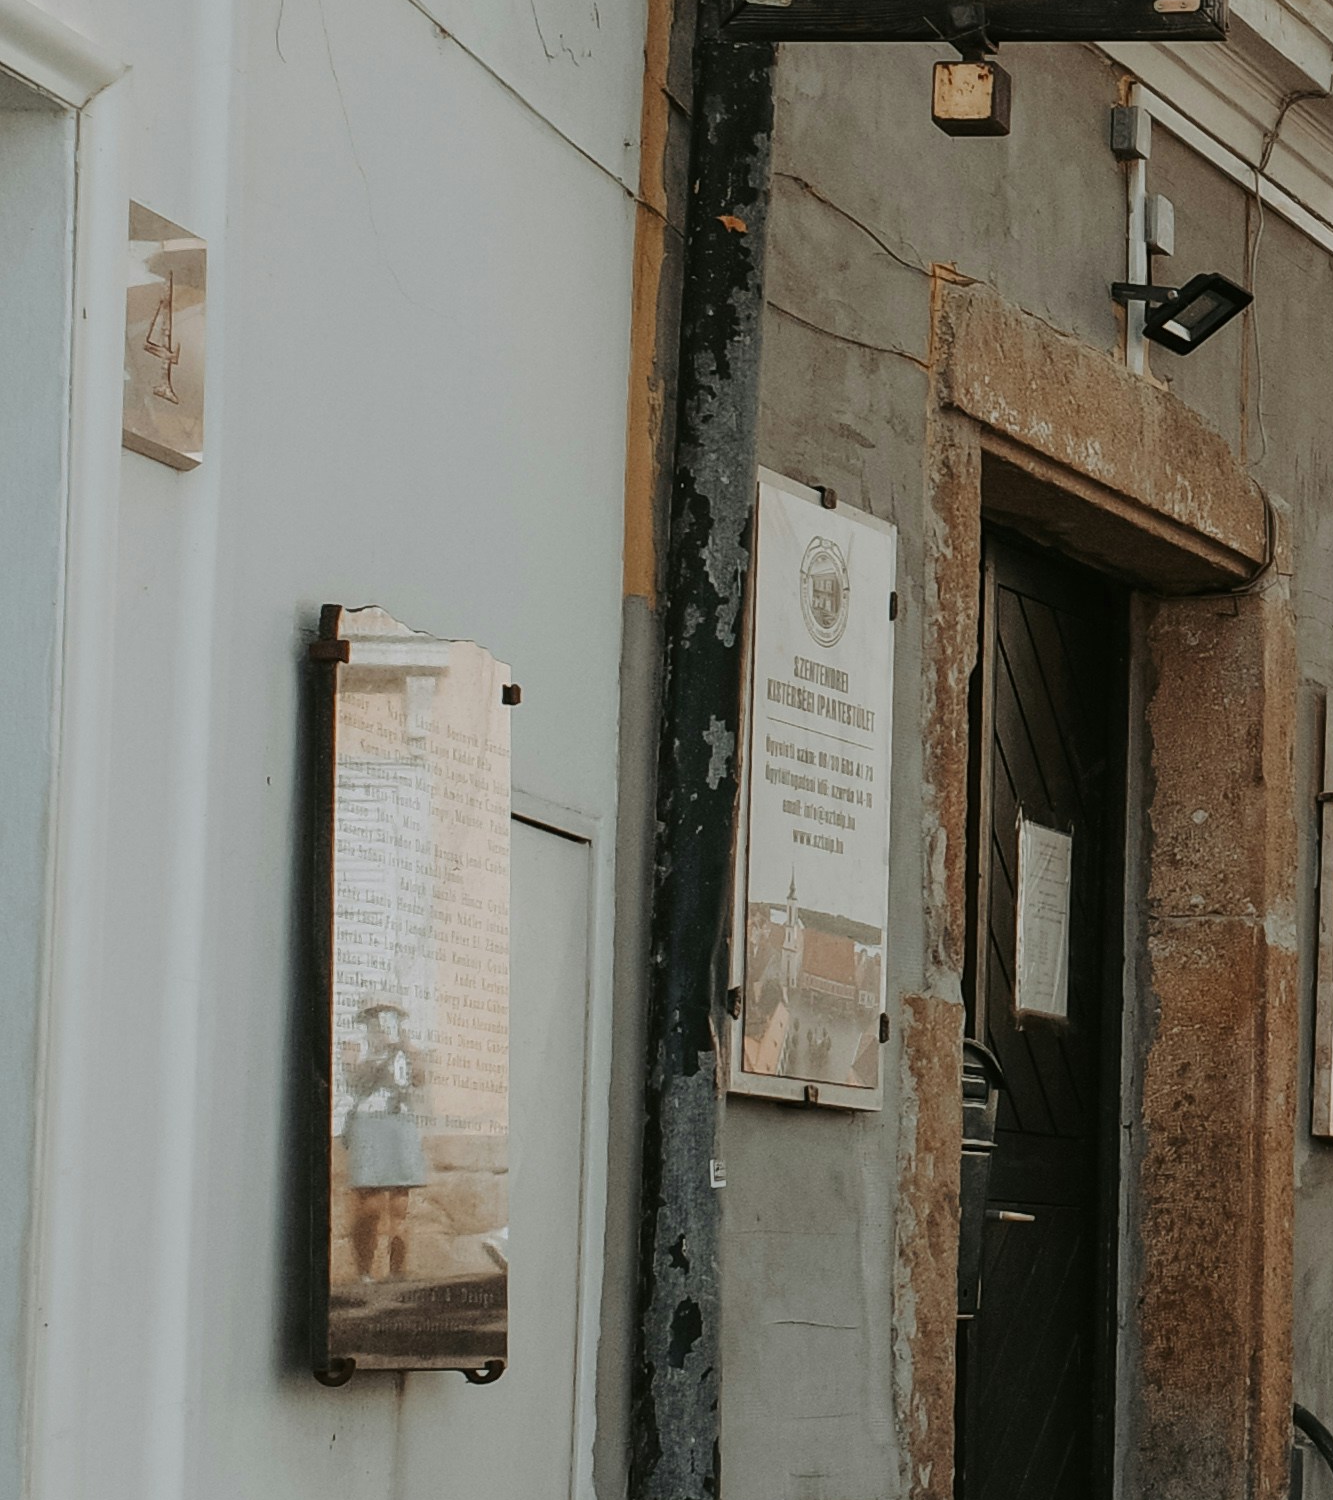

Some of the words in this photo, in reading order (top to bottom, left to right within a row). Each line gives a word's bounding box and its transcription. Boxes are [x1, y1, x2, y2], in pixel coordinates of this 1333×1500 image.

[144, 269, 181, 405] 4
[794, 655, 849, 694] SZENTENDREI
[767, 678, 815, 714] KISTÉRSÉGI
[817, 693, 876, 733] IPARTESTÜLET
[338, 816, 373, 843] Vasarely
[376, 827, 412, 851] Salvador
